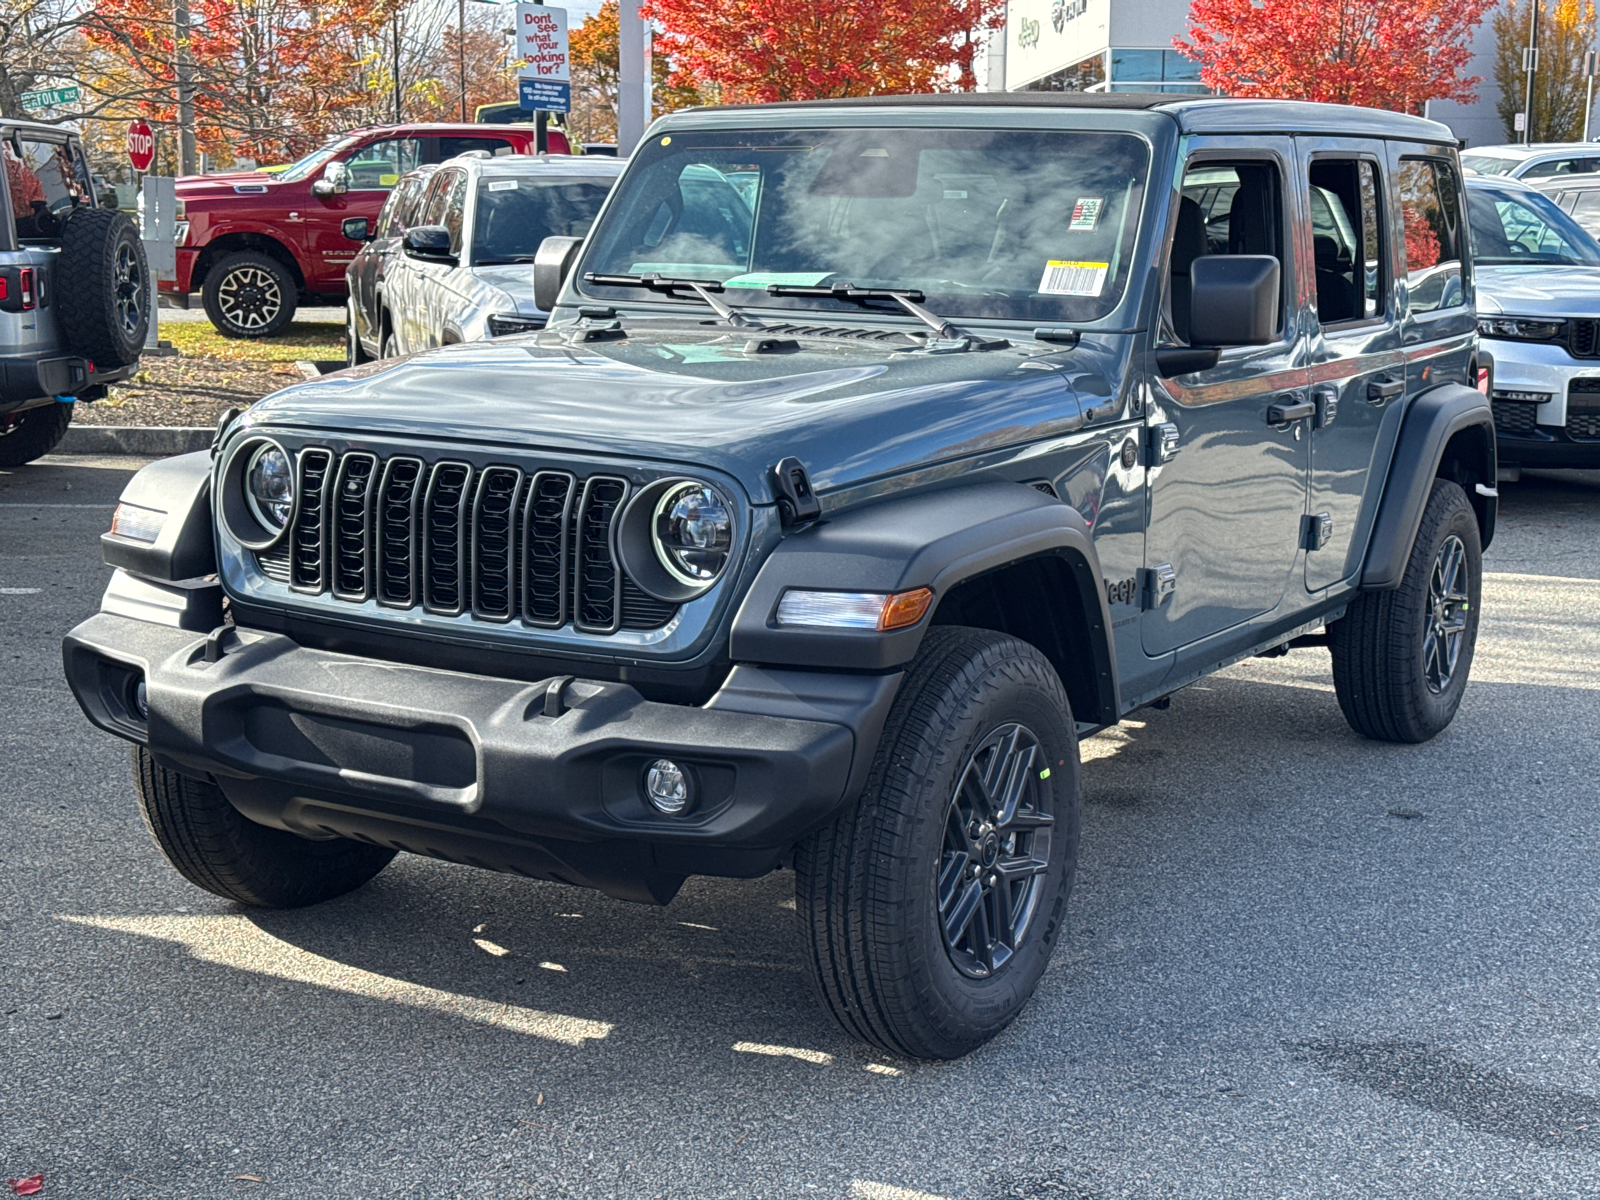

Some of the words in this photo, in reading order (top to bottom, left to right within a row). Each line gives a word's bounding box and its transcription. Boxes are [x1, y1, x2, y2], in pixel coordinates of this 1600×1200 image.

[524, 13, 552, 24] Dont
[537, 23, 558, 33] see
[525, 33, 551, 43] what
[536, 42, 559, 52] your
[523, 51, 565, 64] looking
[537, 63, 560, 75] for?
[129, 133, 152, 155] STOP
